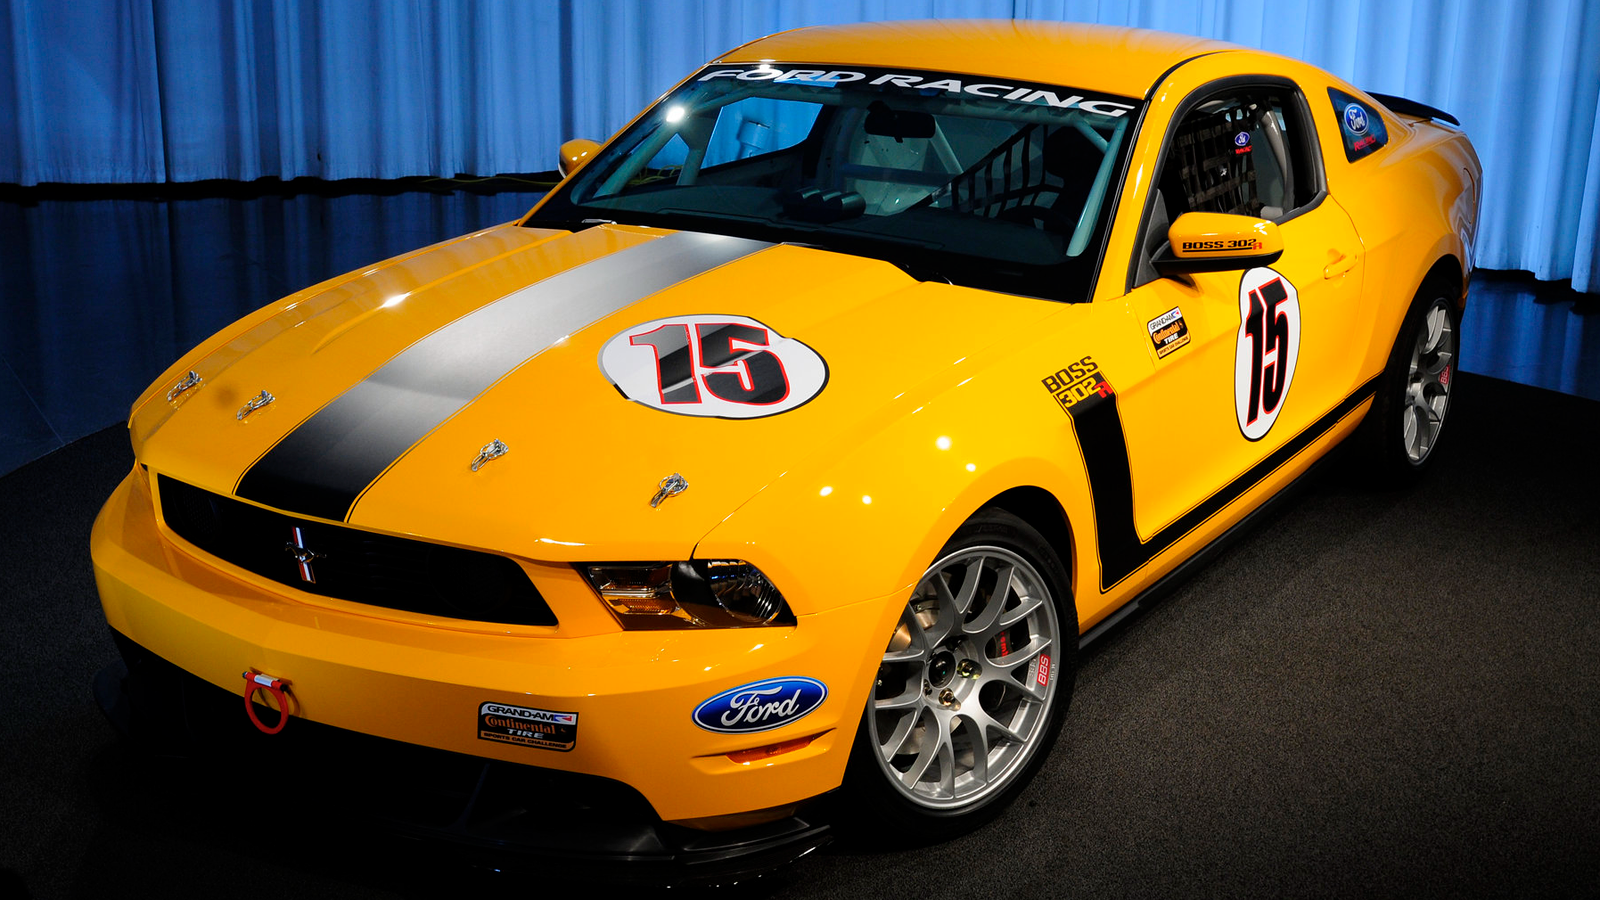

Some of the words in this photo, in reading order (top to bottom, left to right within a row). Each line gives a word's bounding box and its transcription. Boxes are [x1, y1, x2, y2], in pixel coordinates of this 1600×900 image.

[697, 68, 866, 83] FORD
[874, 73, 1136, 118] RACING
[1348, 108, 1366, 131] Ford
[1182, 241, 1224, 249] BOSS
[629, 322, 791, 406] 15
[1245, 276, 1289, 428] 15
[1041, 355, 1099, 394] BOSS
[1038, 655, 1049, 685] BBS
[721, 686, 802, 726] Ford
[485, 714, 556, 735] Continental
[507, 728, 545, 739] TIRE
